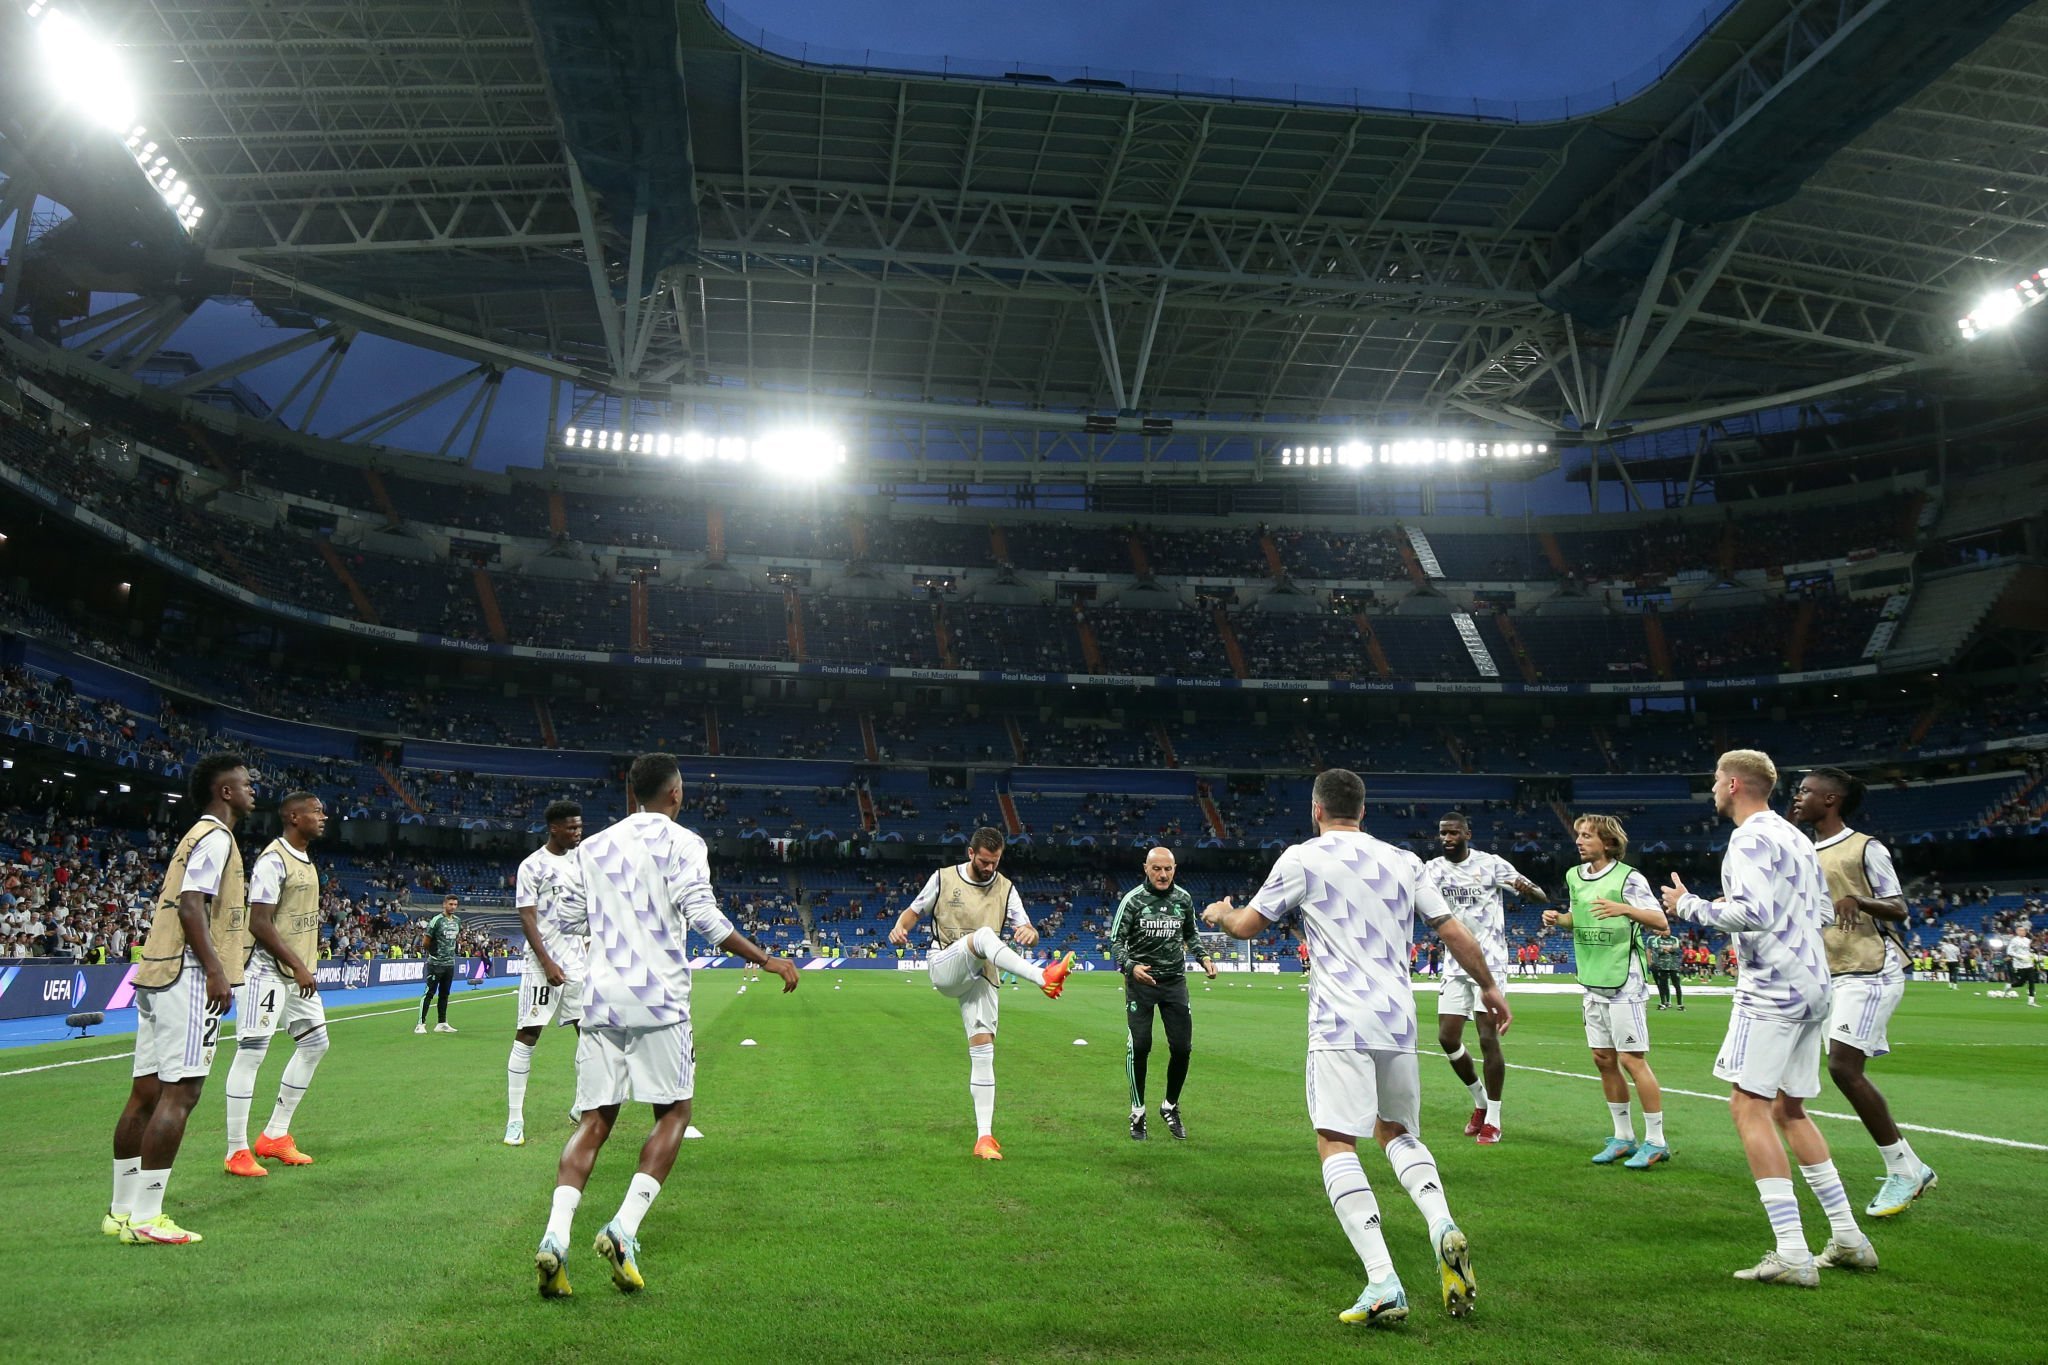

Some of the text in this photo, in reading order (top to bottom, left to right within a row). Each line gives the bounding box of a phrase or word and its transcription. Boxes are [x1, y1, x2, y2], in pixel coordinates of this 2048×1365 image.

[350, 623, 396, 640] Real Madrid
[441, 638, 489, 651] Real Madrid
[536, 651, 586, 661] Real Madrid
[634, 655, 682, 666] Real Madrid
[729, 662, 776, 671] Real Madrid
[822, 665, 868, 675] Real Madrid
[912, 671, 959, 679] Real Madrid
[1001, 673, 1046, 682] Real Madrid
[1089, 677, 1134, 686] Real Madrid
[1195, 679, 1221, 687] Madrid
[1350, 682, 1394, 690] Real Madrid
[1707, 679, 1756, 688] Real Madrid
[1436, 684, 1453, 692] Real
[1524, 684, 1568, 692] Real Madrid
[1140, 918, 1181, 929] Emirates
[43, 979, 72, 1001] UEFA
[532, 985, 550, 1006] 18
[260, 989, 276, 1013] 4
[202, 1017, 221, 1047] 2
